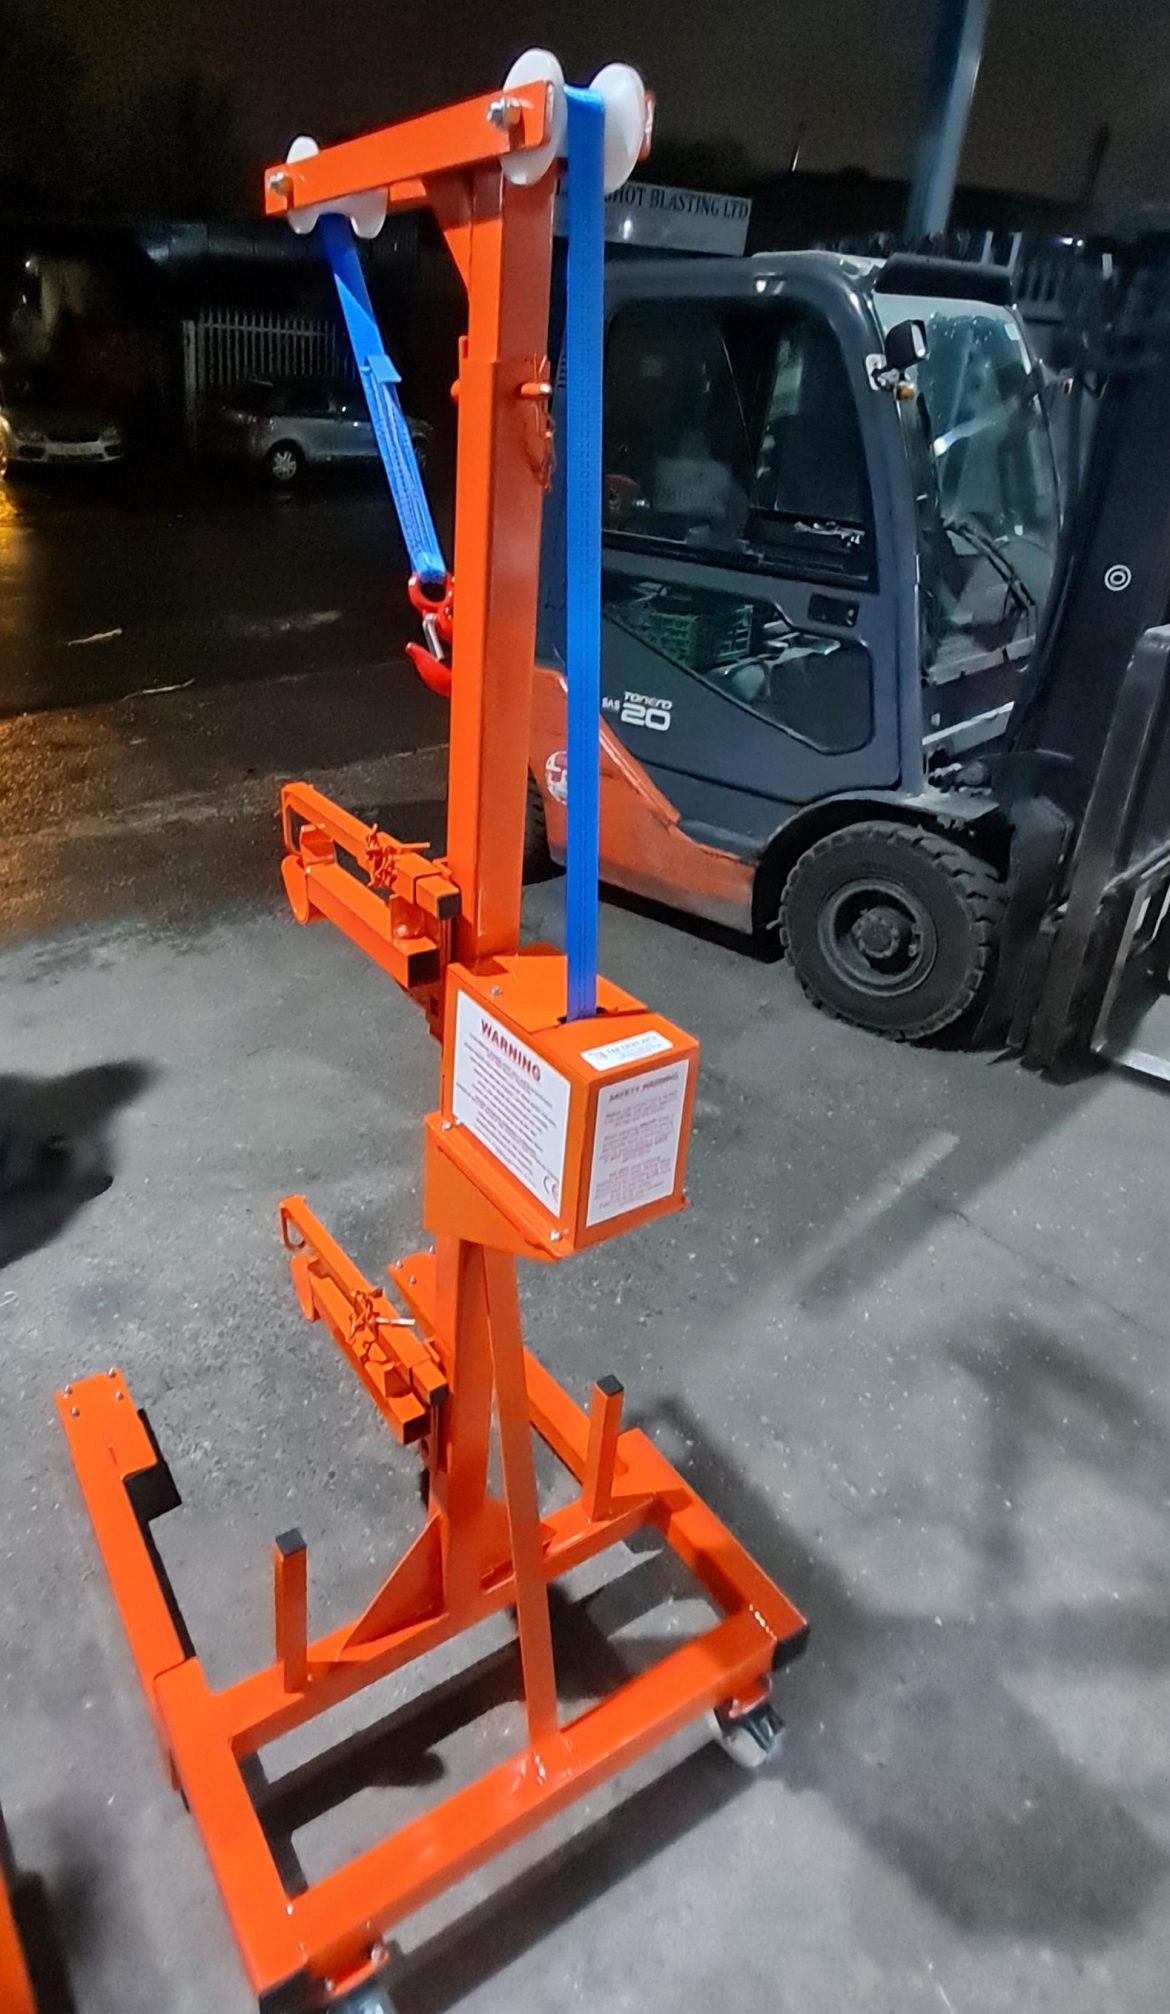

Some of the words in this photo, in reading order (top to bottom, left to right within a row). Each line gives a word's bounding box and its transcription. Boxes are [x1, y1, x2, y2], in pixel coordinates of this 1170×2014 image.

[649, 187, 720, 217] BLASTING
[723, 200, 748, 218] LTD
[621, 702, 671, 731] 20
[481, 1018, 542, 1083] WARNING
